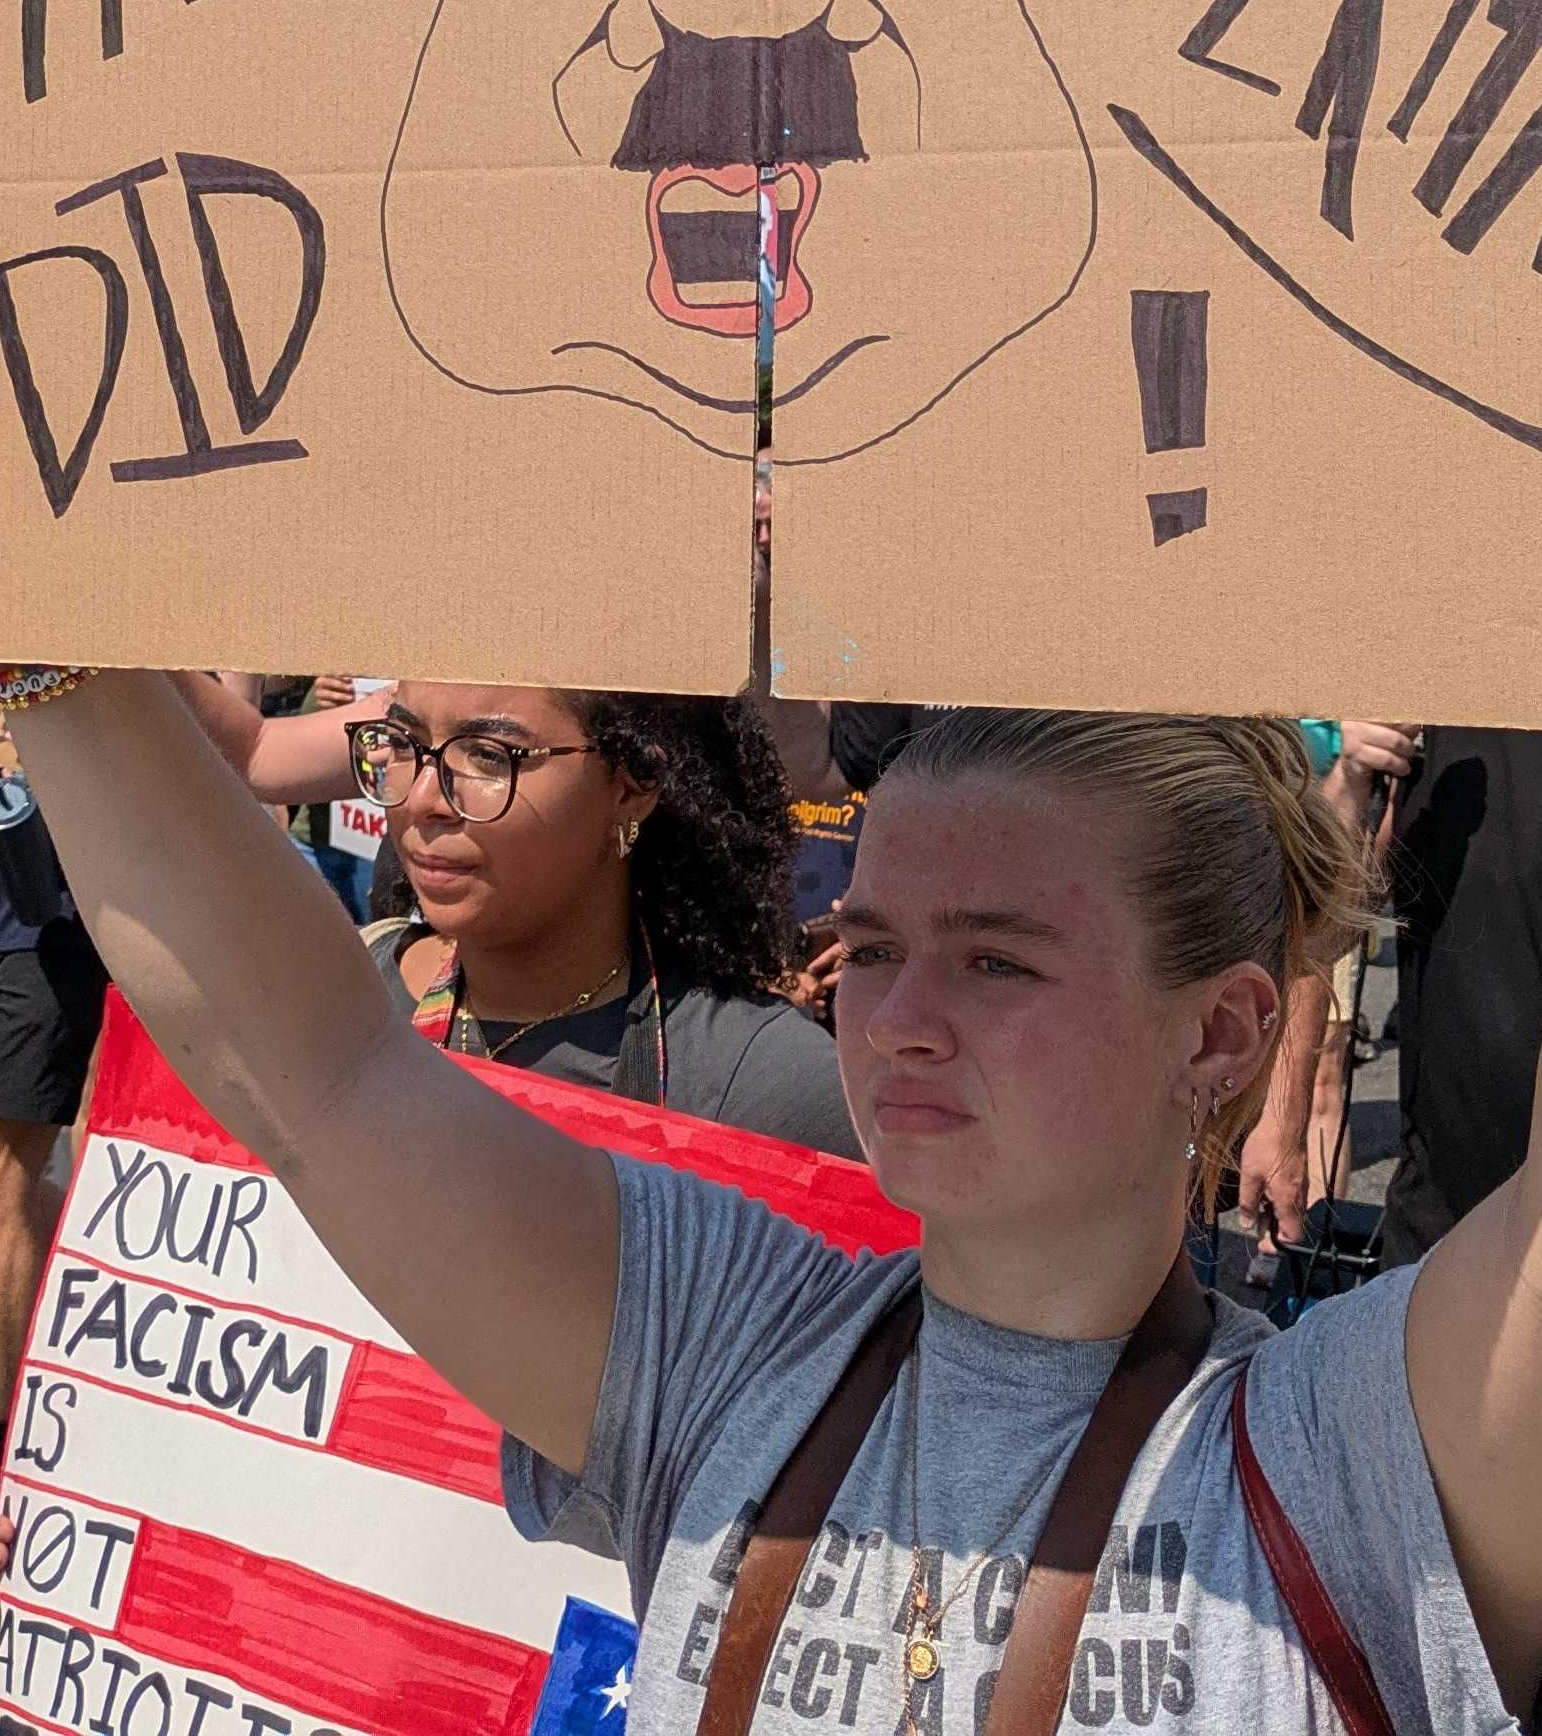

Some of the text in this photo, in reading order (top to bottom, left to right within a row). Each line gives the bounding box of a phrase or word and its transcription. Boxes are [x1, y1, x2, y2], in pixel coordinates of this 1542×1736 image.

[83, 1143, 267, 1284] YOUR
[48, 1268, 329, 1439] FACISM
[14, 1375, 77, 1473] IS
[677, 1602, 881, 1726] EECT
[974, 1622, 1196, 1736] CUS
